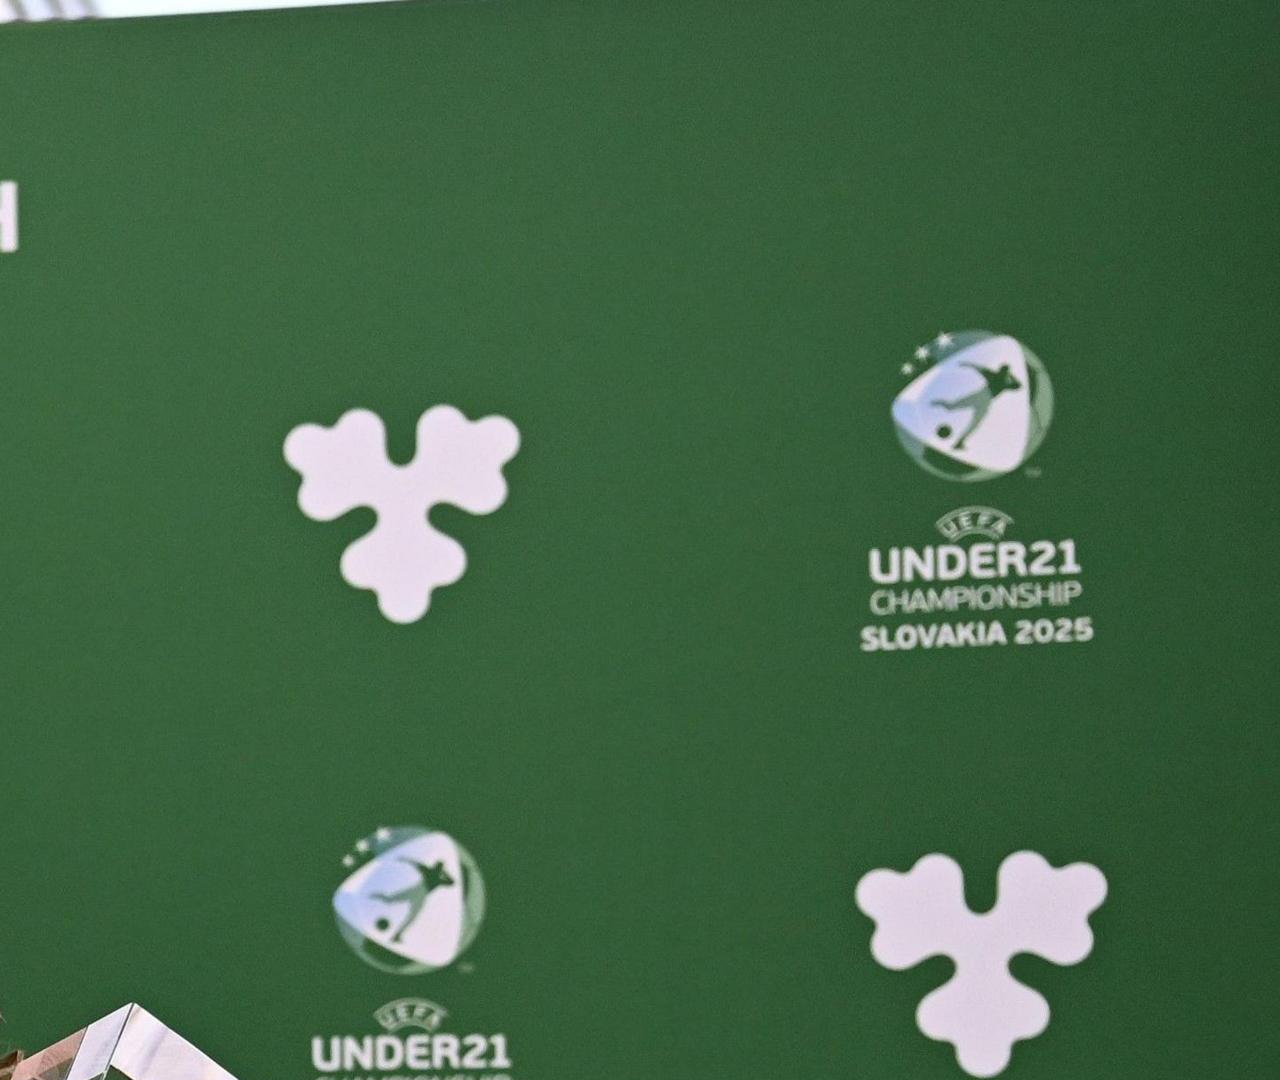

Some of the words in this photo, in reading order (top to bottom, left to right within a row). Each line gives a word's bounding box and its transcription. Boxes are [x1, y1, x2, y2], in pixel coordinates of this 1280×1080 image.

[869, 539, 1082, 584] UNDER21
[869, 580, 1082, 615] CHAMPIONSHIP
[860, 621, 1008, 651] SLOVAKIA
[1015, 617, 1094, 644] 2025
[312, 1034, 512, 1072] UNDER21
